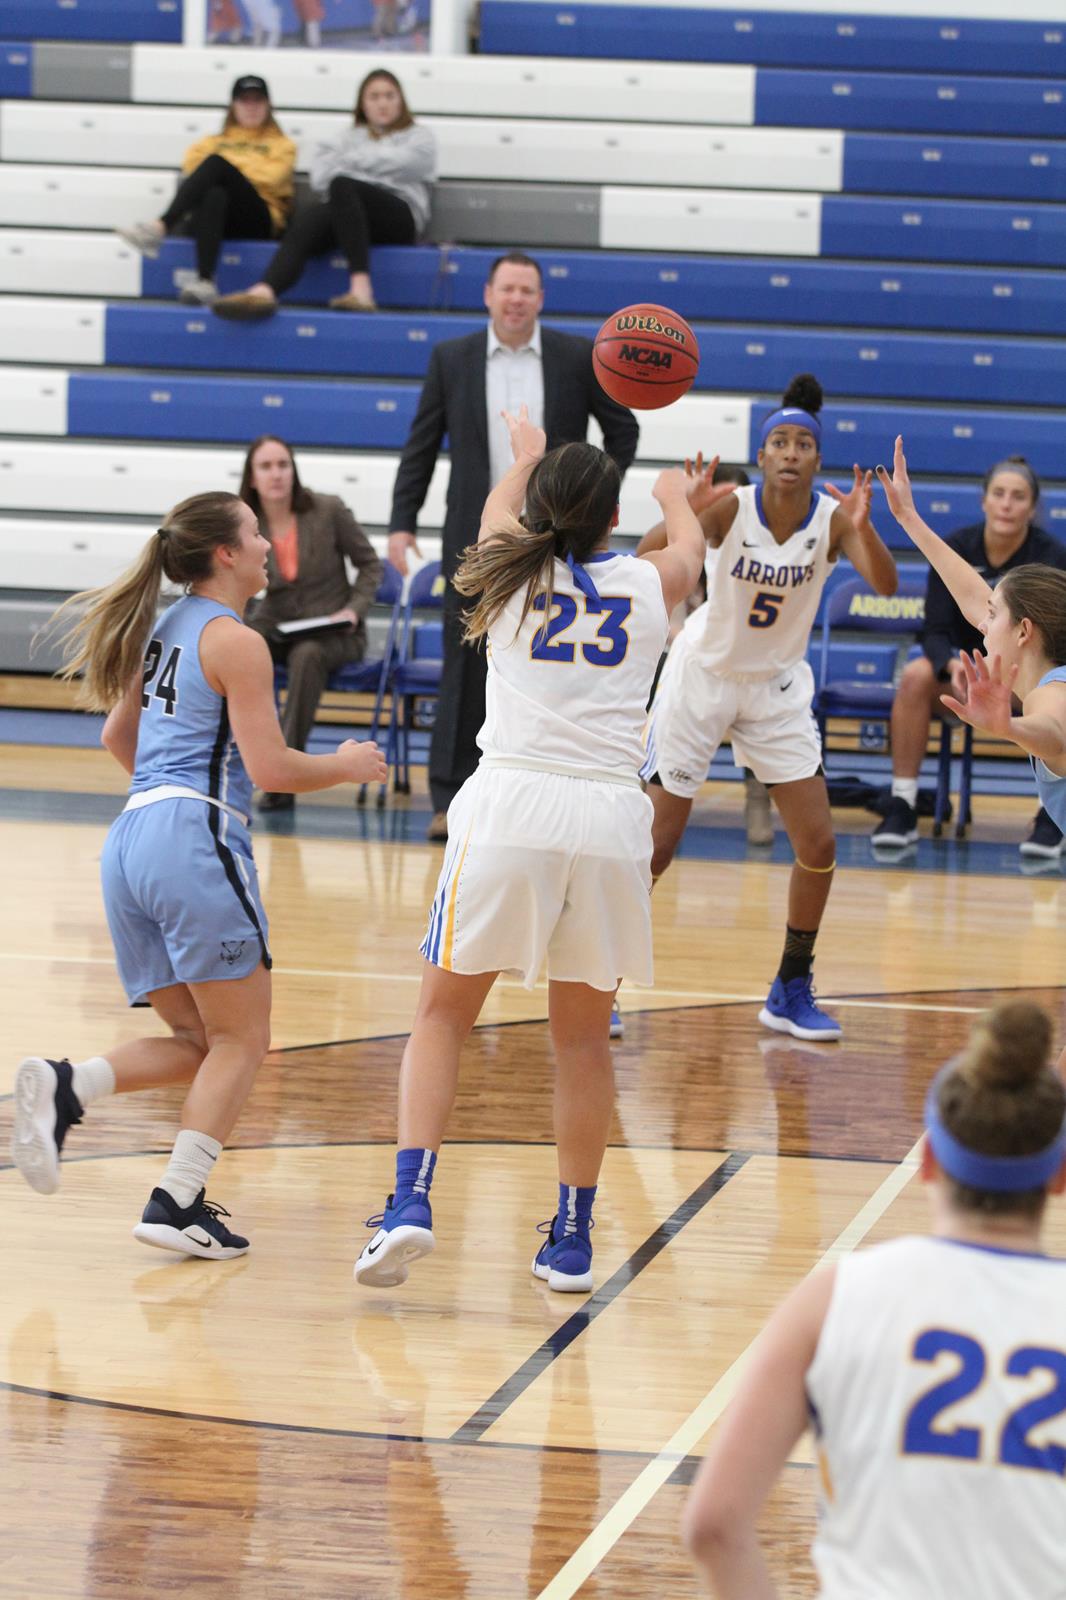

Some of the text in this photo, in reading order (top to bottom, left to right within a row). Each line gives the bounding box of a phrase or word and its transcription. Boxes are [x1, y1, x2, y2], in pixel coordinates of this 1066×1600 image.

[616, 315, 686, 344] Wilson
[618, 343, 673, 369] NCAA
[529, 591, 633, 669] 23
[747, 591, 785, 629] 5
[141, 639, 184, 717] 24
[899, 1323, 1066, 1482] 22
